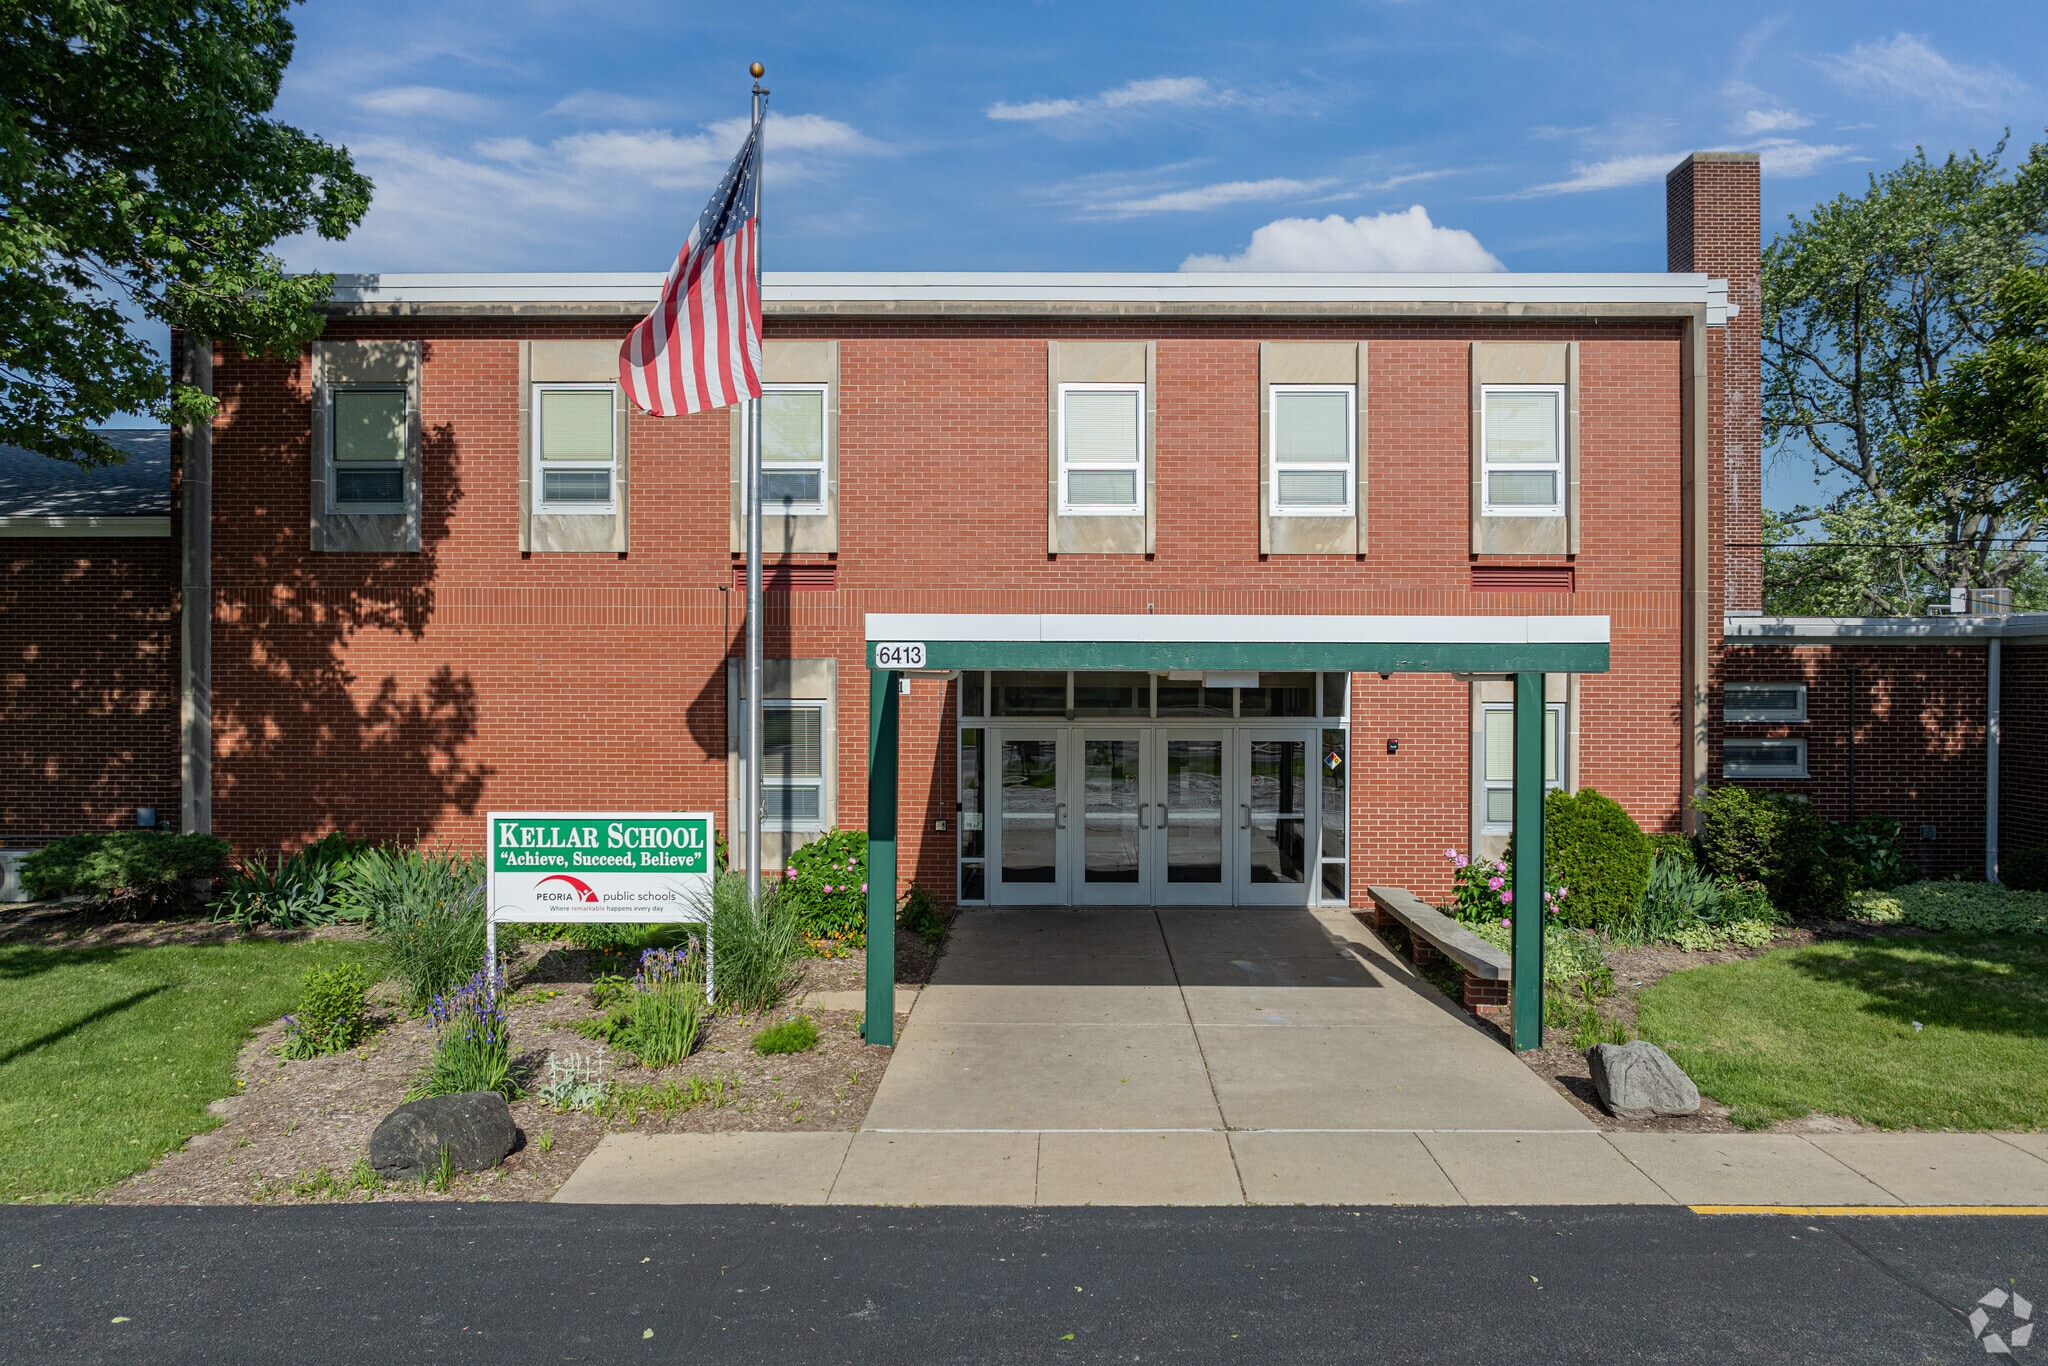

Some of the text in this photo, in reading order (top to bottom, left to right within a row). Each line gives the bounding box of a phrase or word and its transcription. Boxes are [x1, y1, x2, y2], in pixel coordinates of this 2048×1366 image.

[879, 646, 921, 664] 6413
[498, 823, 704, 848] KELLAR SCHOOL
[500, 851, 702, 868] “Achieve, Succeed, Believe”
[536, 891, 676, 903] PEORIA public schools
